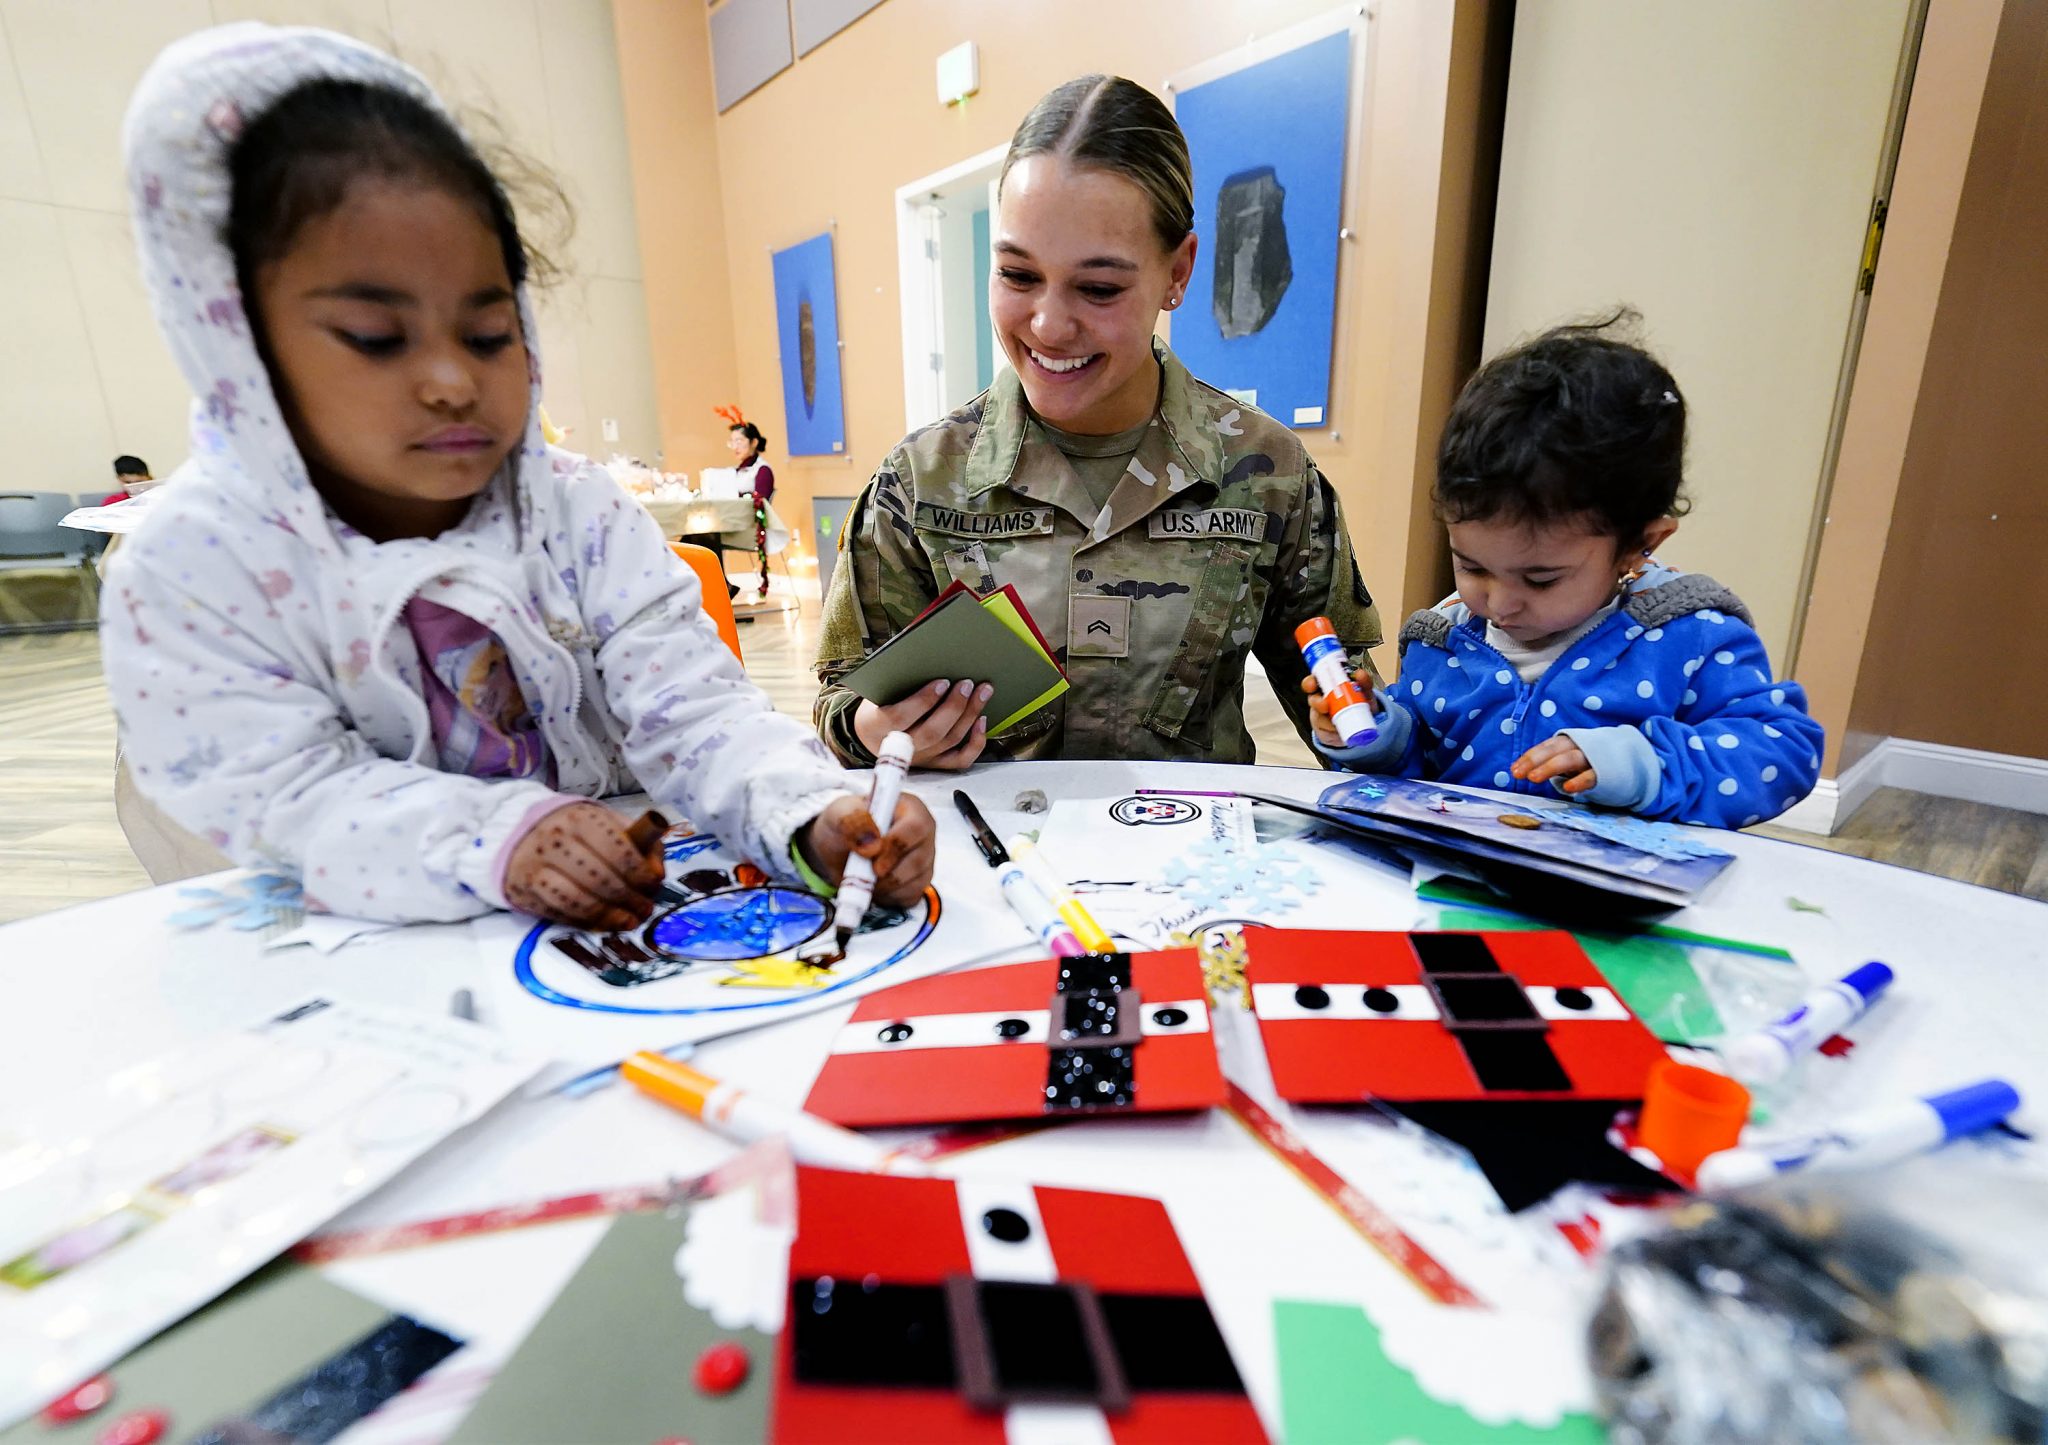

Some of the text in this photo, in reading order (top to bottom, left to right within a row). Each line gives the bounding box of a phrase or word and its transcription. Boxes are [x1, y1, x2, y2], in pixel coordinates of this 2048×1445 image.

[932, 508, 1037, 534] WILLIAMS
[1162, 511, 1257, 537] U.S. ARMY
